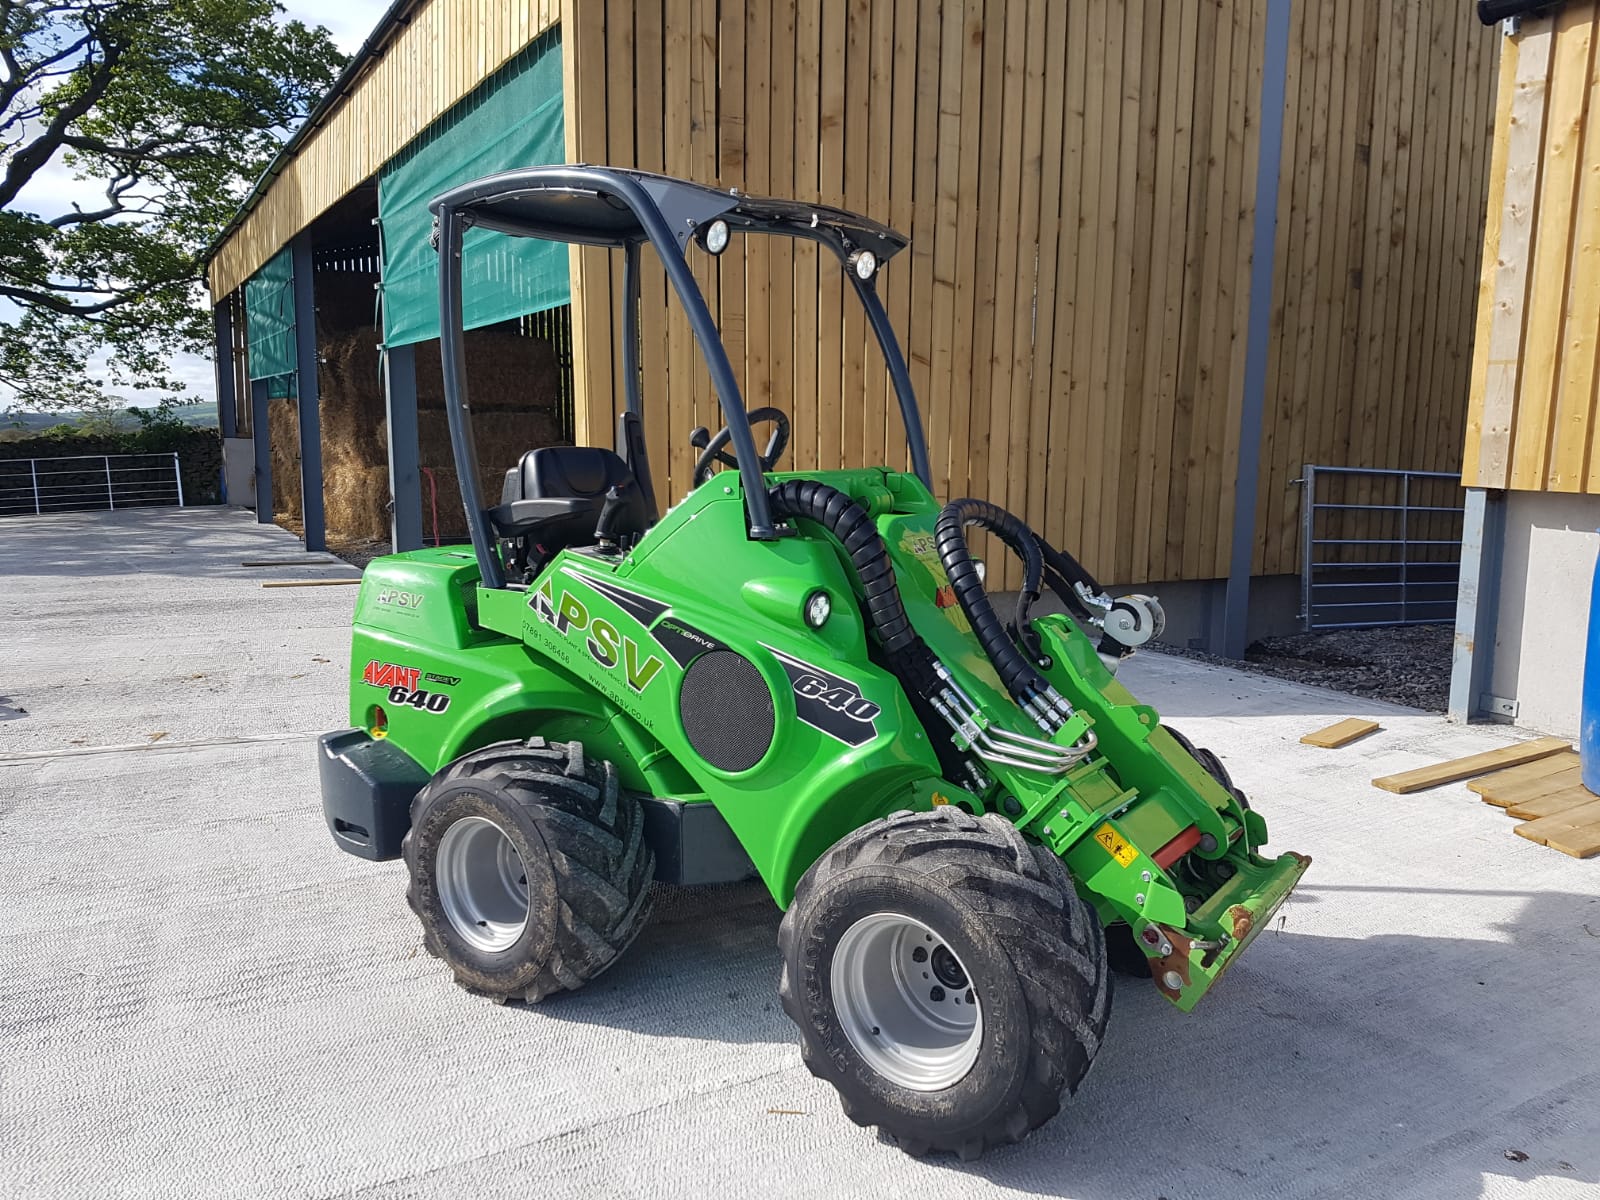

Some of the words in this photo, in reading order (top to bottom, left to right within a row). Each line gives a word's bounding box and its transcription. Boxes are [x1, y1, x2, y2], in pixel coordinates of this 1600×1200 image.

[376, 589, 424, 608] APSV
[527, 575, 665, 694] APSV
[660, 620, 716, 649] OPTIDRIVE
[361, 660, 422, 695] AVANT
[387, 685, 452, 715] 640
[588, 672, 655, 730] www.apsv.co.uk
[793, 674, 882, 723] 640
